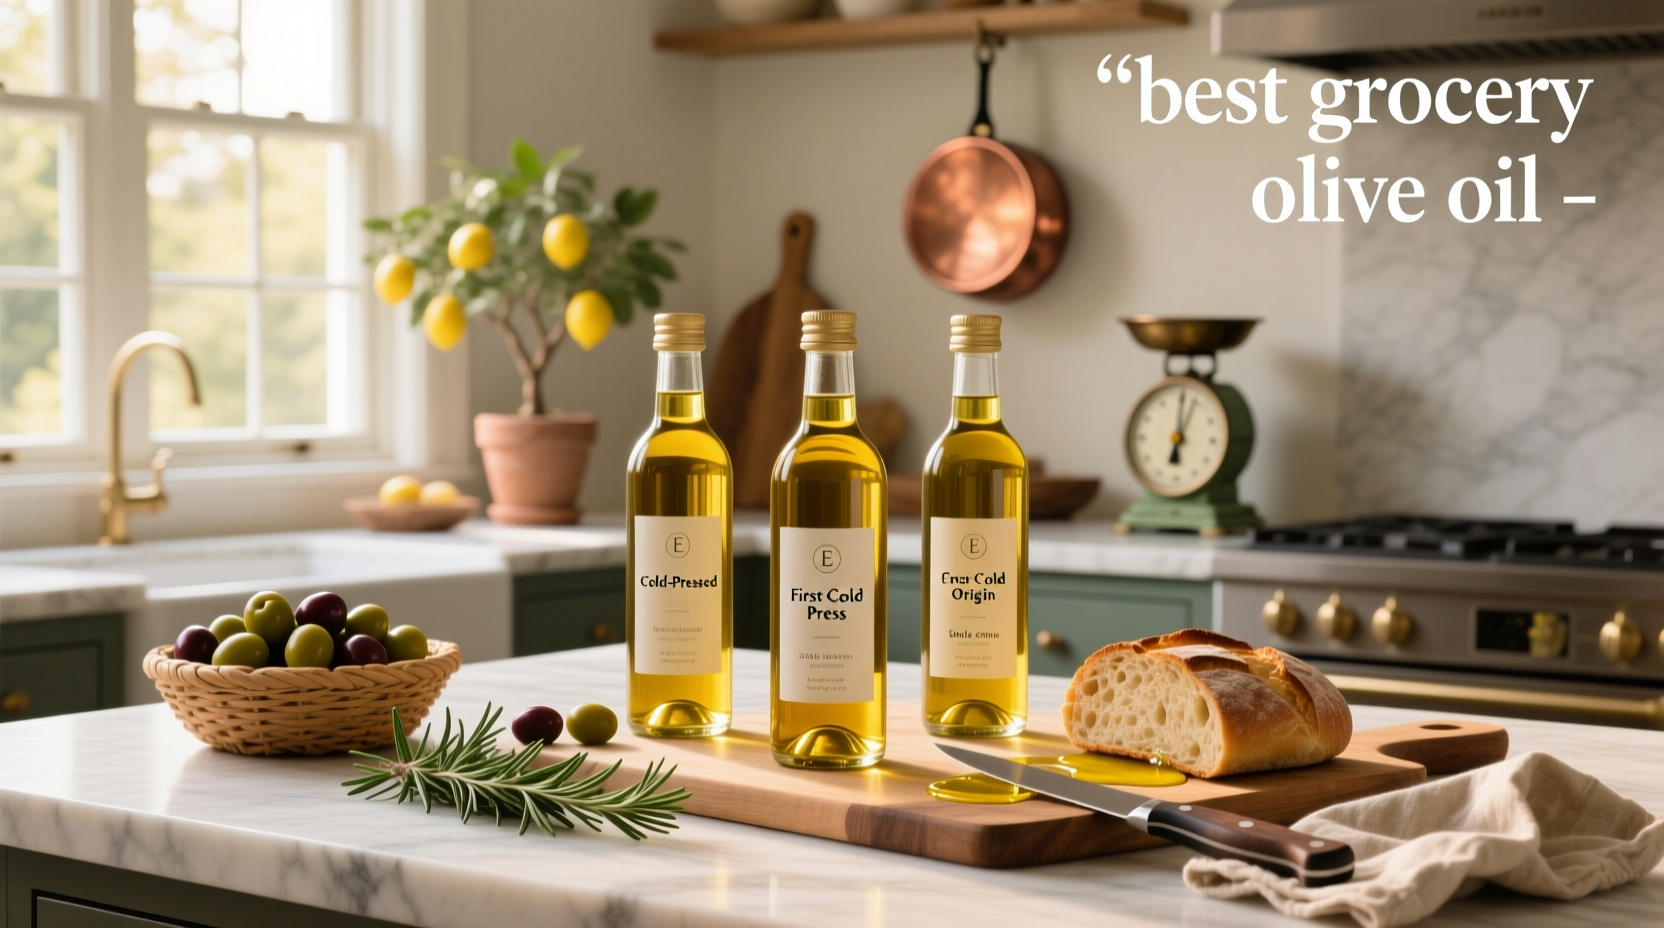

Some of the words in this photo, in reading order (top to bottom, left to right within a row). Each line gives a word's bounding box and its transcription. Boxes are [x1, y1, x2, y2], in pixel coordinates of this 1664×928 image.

[673, 536, 684, 553] E
[970, 538, 980, 554] E
[822, 550, 834, 567] E
[974, 571, 1006, 585] Cold
[791, 587, 823, 603] First
[826, 587, 863, 603] Cold
[951, 587, 996, 605] Origin
[807, 605, 847, 621] Press
